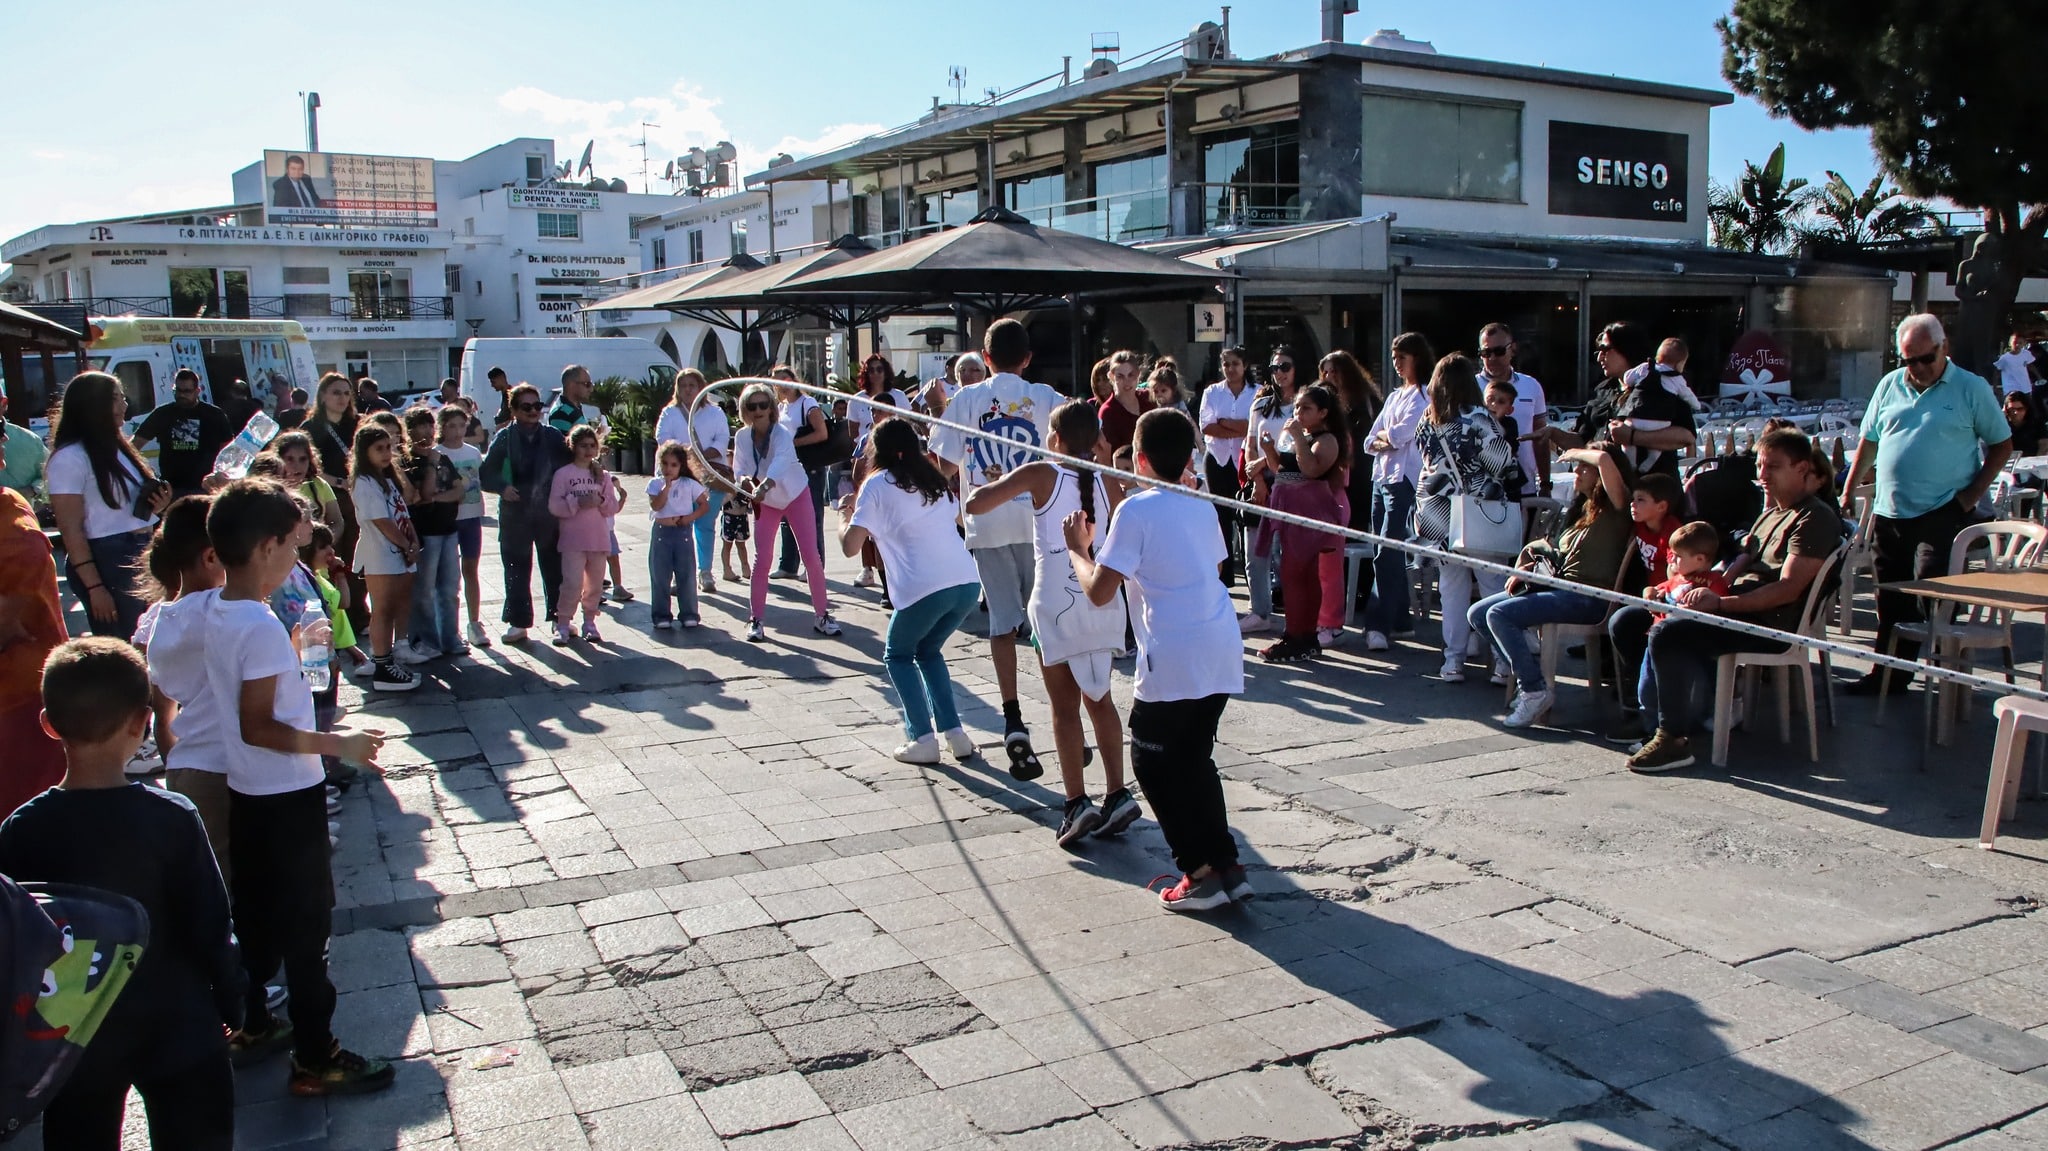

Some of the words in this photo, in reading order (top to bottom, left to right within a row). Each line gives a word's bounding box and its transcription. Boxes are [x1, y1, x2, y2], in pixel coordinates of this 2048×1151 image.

[1577, 156, 1669, 190] SENSO
[512, 188, 566, 197] ΟΔΟΝΤΙΑΤΡΙΚΗ
[524, 195, 556, 203] DENTAL
[560, 197, 587, 205] CLINIC
[1652, 198, 1683, 212] cafe
[262, 231, 305, 241] Δ.Ε.Π.Ε
[310, 231, 378, 242] (ΔΙΚΗΓΟΡΙΚΟ
[383, 232, 430, 244] ΓΡΑΦΕΙΟ)
[528, 255, 540, 263] Dr.
[541, 255, 568, 264] NICOS
[570, 256, 626, 265] PH.PITTADJIS
